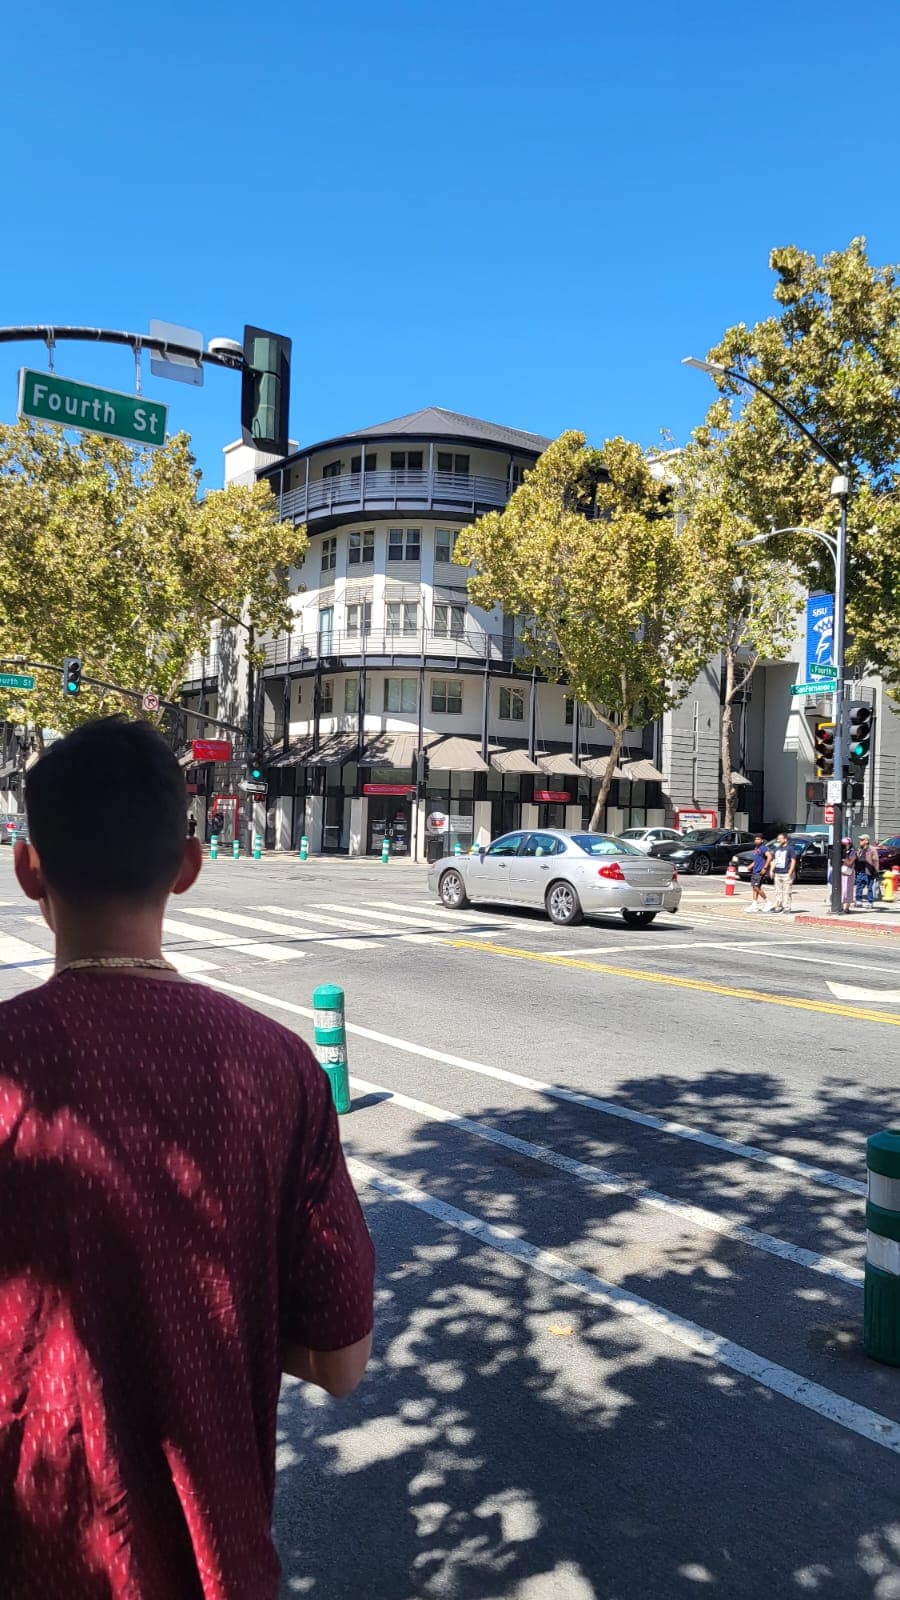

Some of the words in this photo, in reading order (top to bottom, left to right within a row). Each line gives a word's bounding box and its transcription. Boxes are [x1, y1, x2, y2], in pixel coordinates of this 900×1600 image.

[32, 383, 116, 425] Fourth
[133, 408, 159, 435] St
[812, 607, 827, 617] SJSU
[814, 666, 832, 676] Fourth
